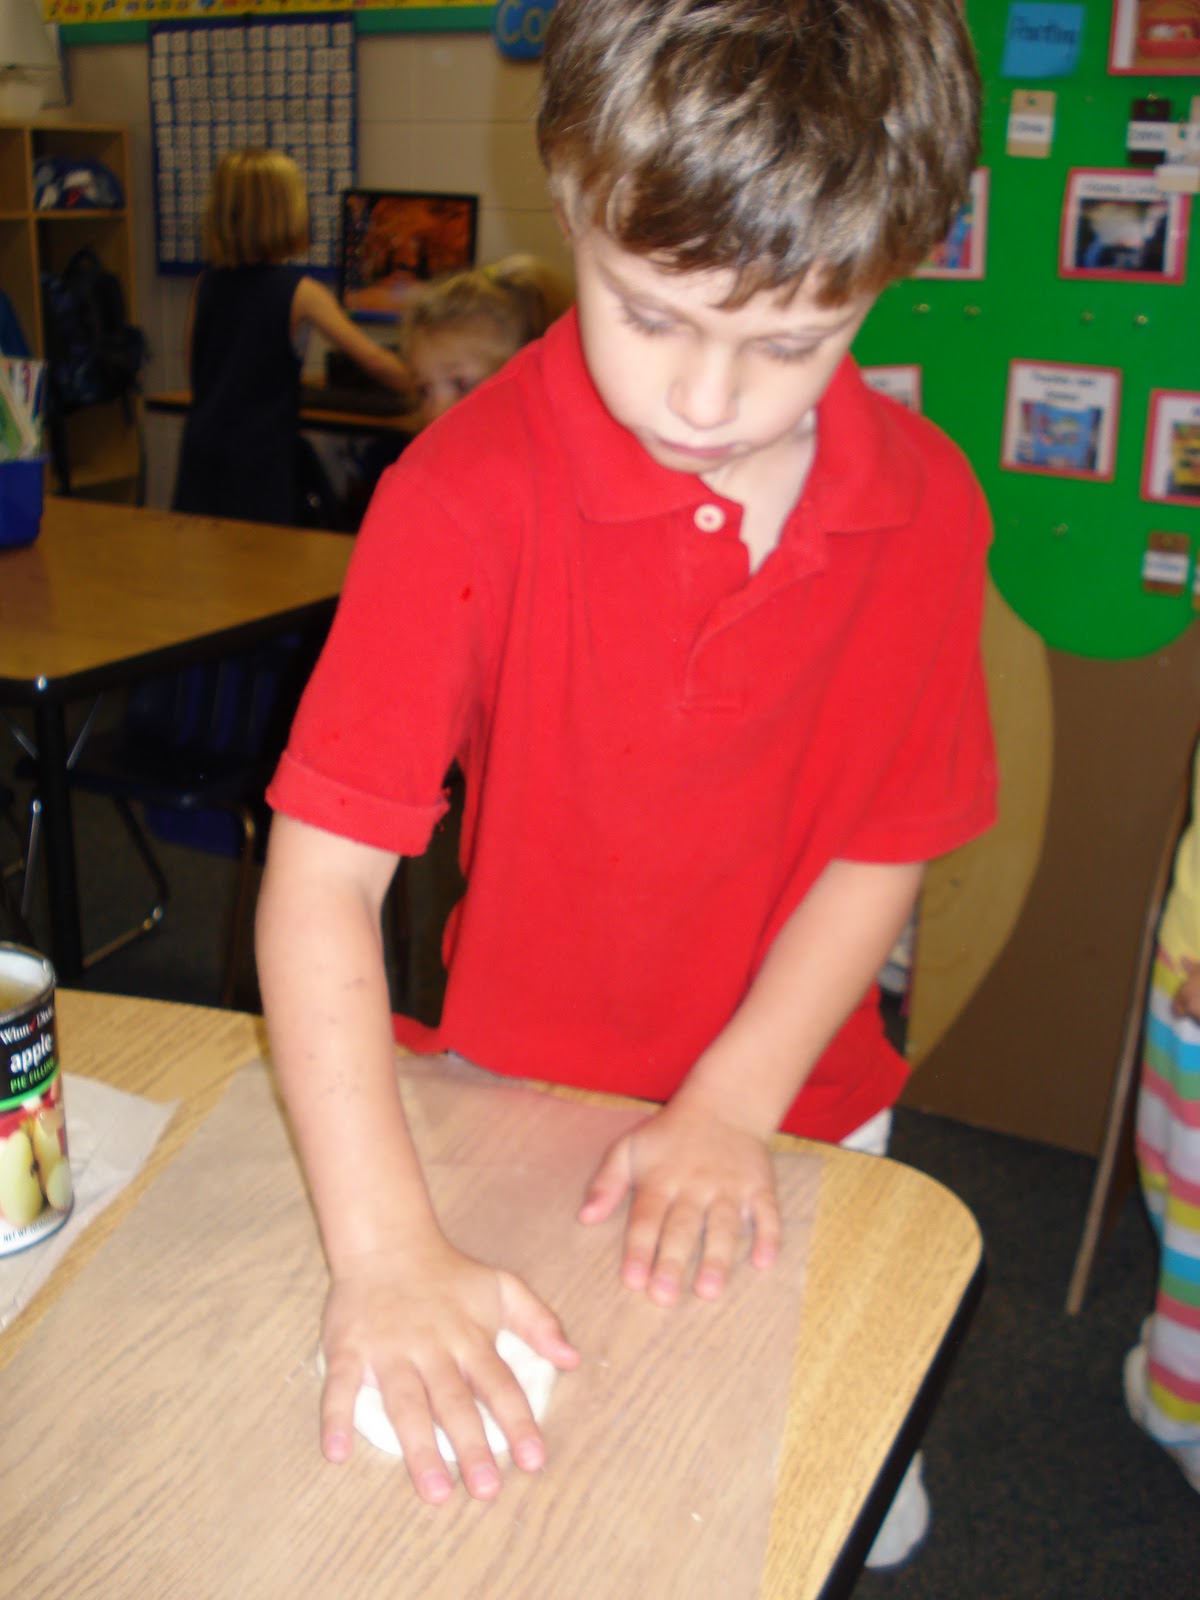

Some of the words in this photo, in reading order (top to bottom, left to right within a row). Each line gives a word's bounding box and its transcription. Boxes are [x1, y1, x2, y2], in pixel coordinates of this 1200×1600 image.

[0, 1023, 30, 1046] Winn
[10, 1032, 53, 1073] apple
[10, 1075, 27, 1093] PIE
